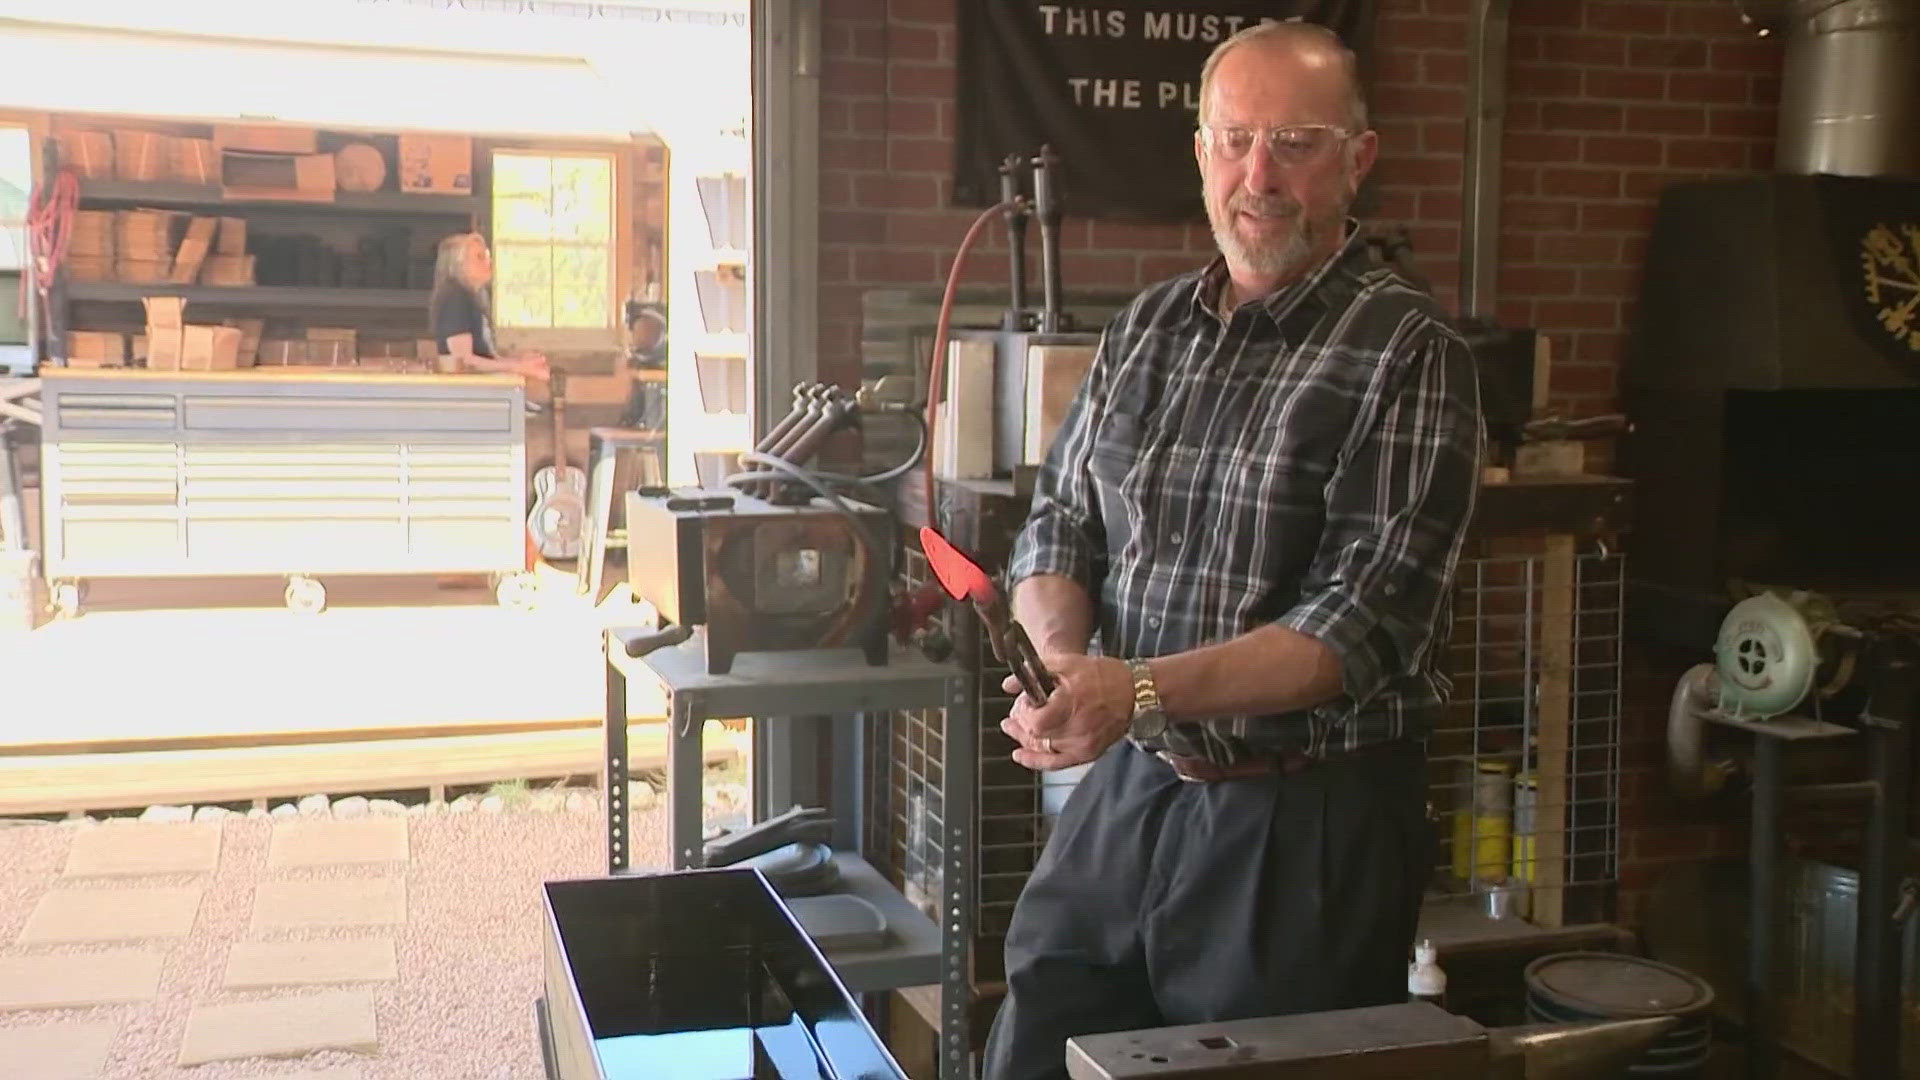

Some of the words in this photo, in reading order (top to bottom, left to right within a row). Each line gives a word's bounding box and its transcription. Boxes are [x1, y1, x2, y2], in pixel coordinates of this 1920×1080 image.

[1039, 5, 1126, 38] THIS
[1144, 11, 1244, 42] MUST
[1068, 78, 1142, 109] THE
[1158, 81, 1201, 109] PL
